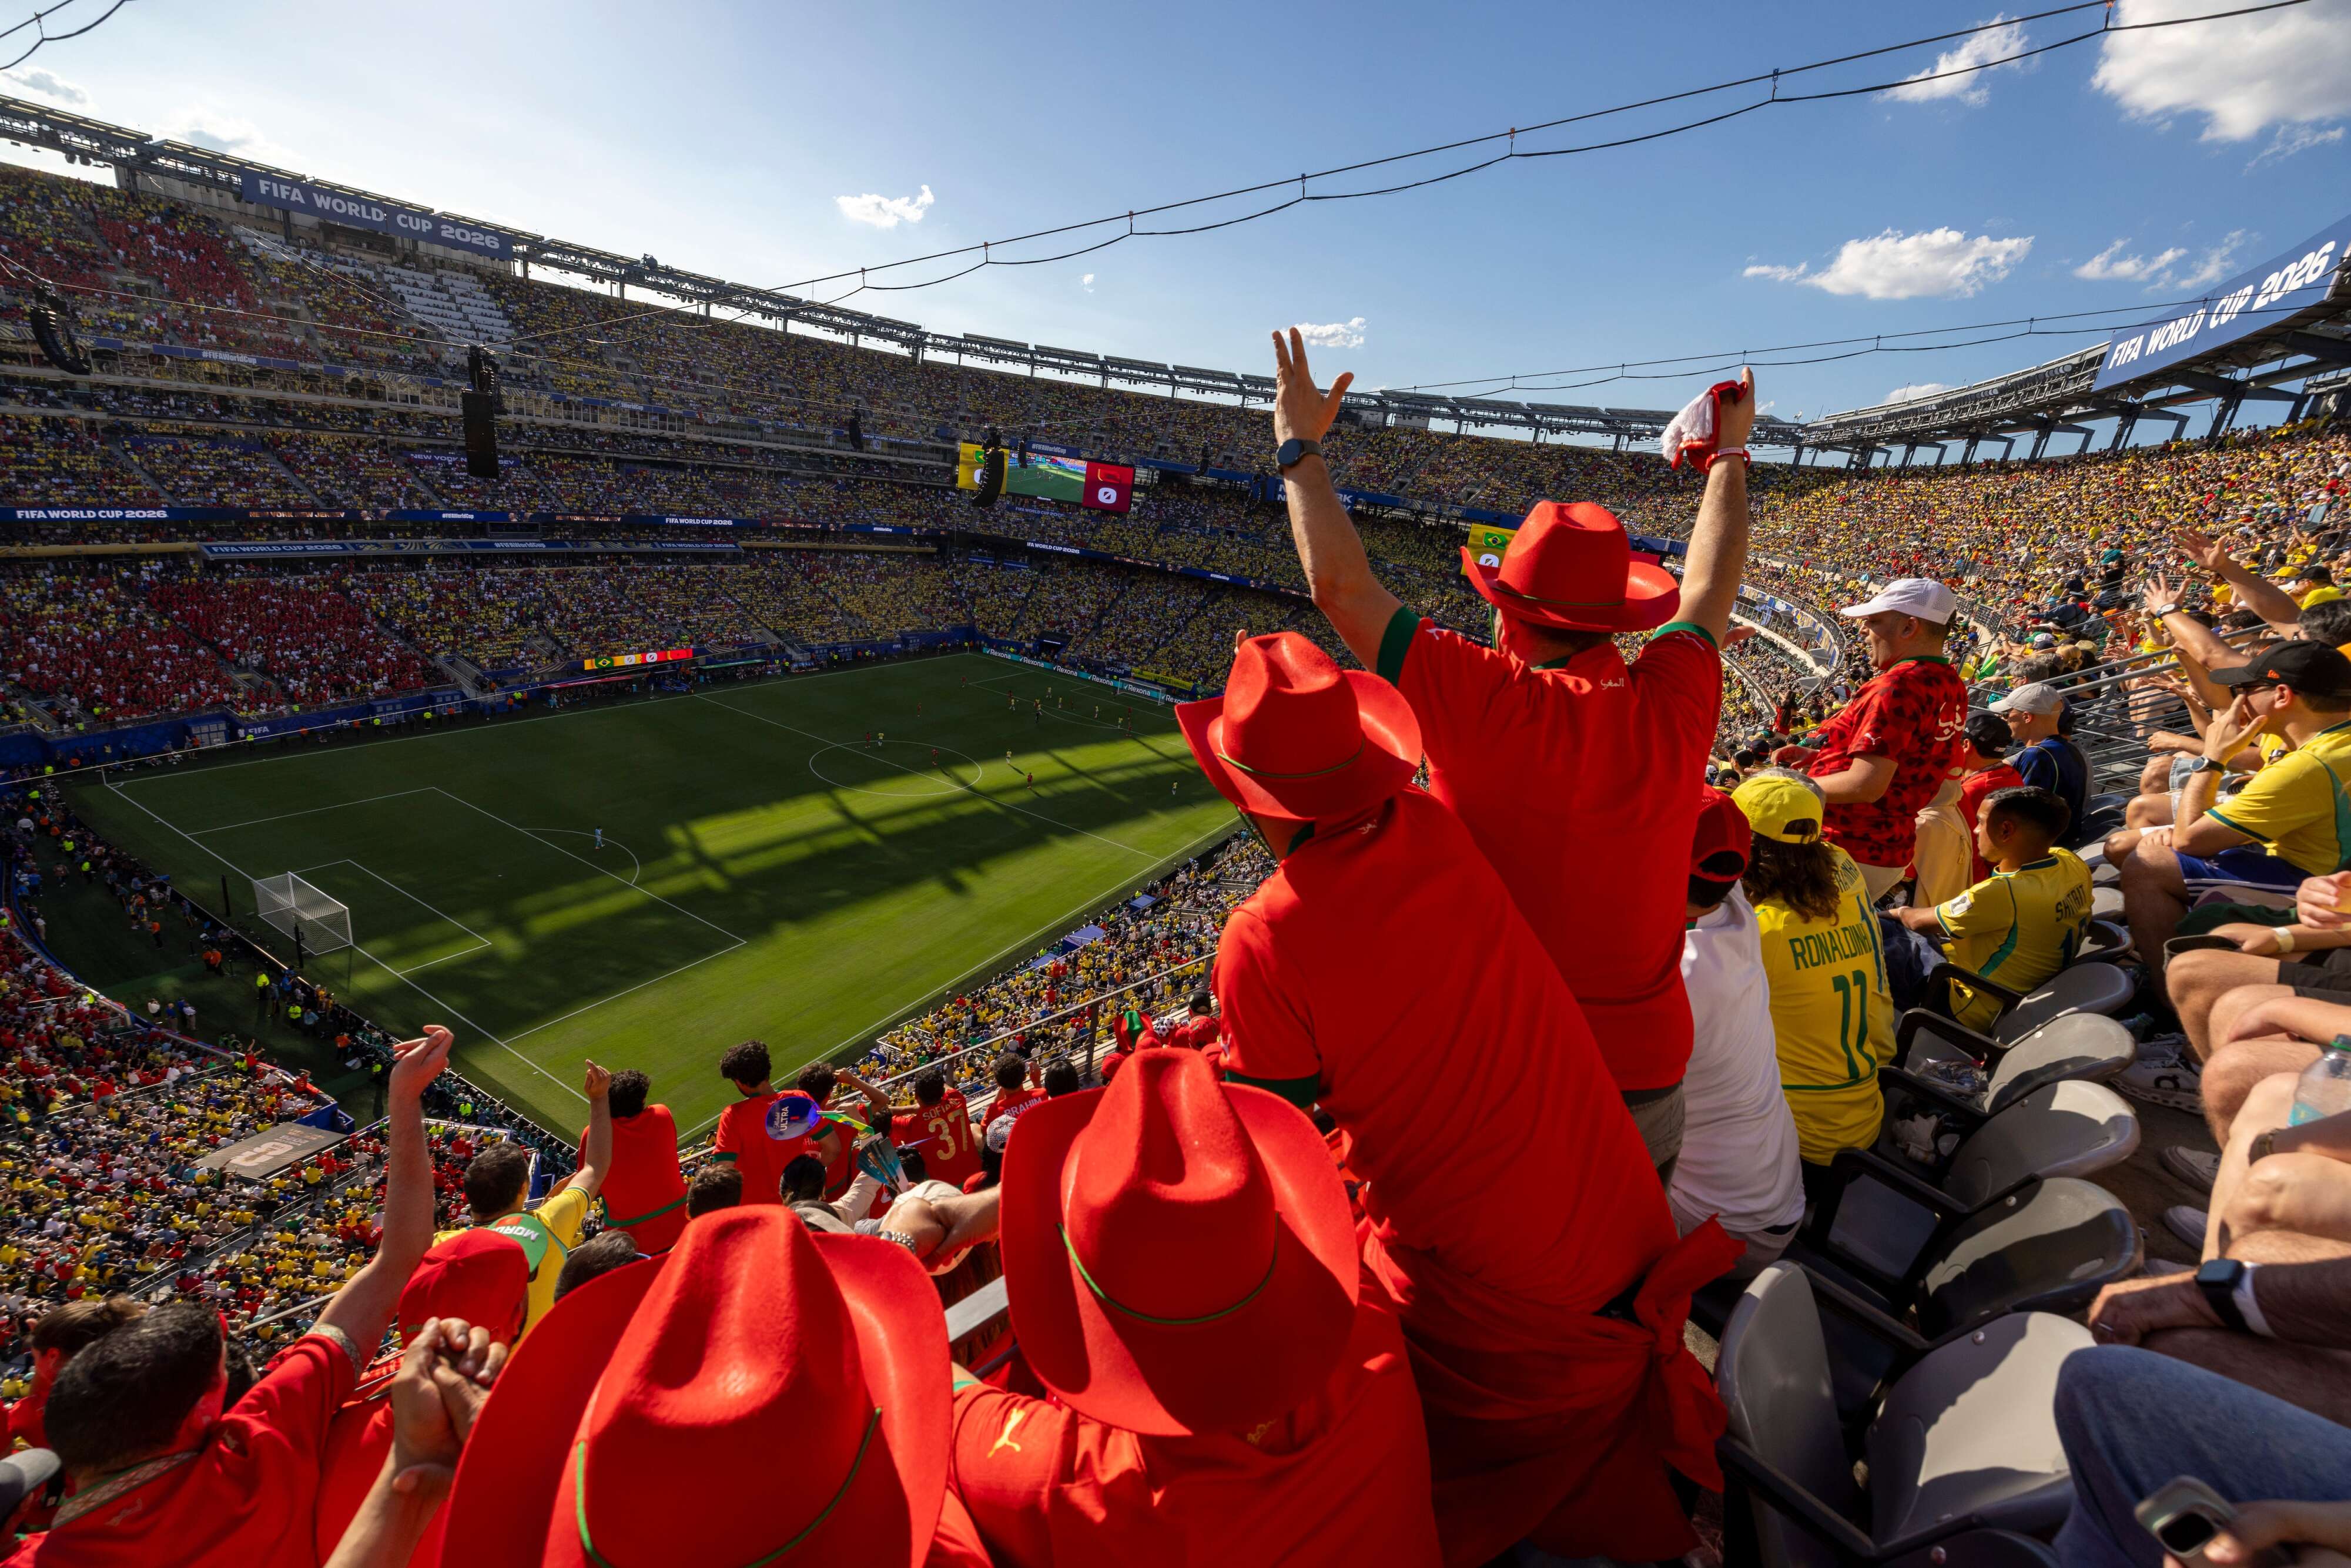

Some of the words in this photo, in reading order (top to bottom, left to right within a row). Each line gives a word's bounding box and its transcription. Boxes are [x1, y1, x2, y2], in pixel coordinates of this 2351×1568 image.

[258, 178, 306, 204] FIFA
[312, 192, 386, 222] WORLD
[397, 213, 433, 233] CUP
[441, 225, 500, 249] 2026
[2108, 334, 2145, 370] FIFA
[2145, 308, 2206, 356] WORLD
[2209, 284, 2254, 329] CUP
[2252, 240, 2336, 311] 2026
[202, 351, 257, 364] #FIFAWorldCup
[1032, 444, 1066, 454] #FIFAWorldCup
[1098, 487, 1117, 504] 0
[16, 510, 47, 518] FIFA
[990, 648, 1012, 659] Rexona
[1023, 656, 1044, 668] Rexona
[1057, 665, 1078, 676] Rexona
[1091, 674, 1113, 685] Rexona
[1128, 684, 1151, 696] Rexona
[248, 726, 270, 734] FIFA
[1004, 1097, 1042, 1117] BRAHIM
[780, 1105, 789, 1131] ULTRA
[928, 1108, 968, 1161] 37
